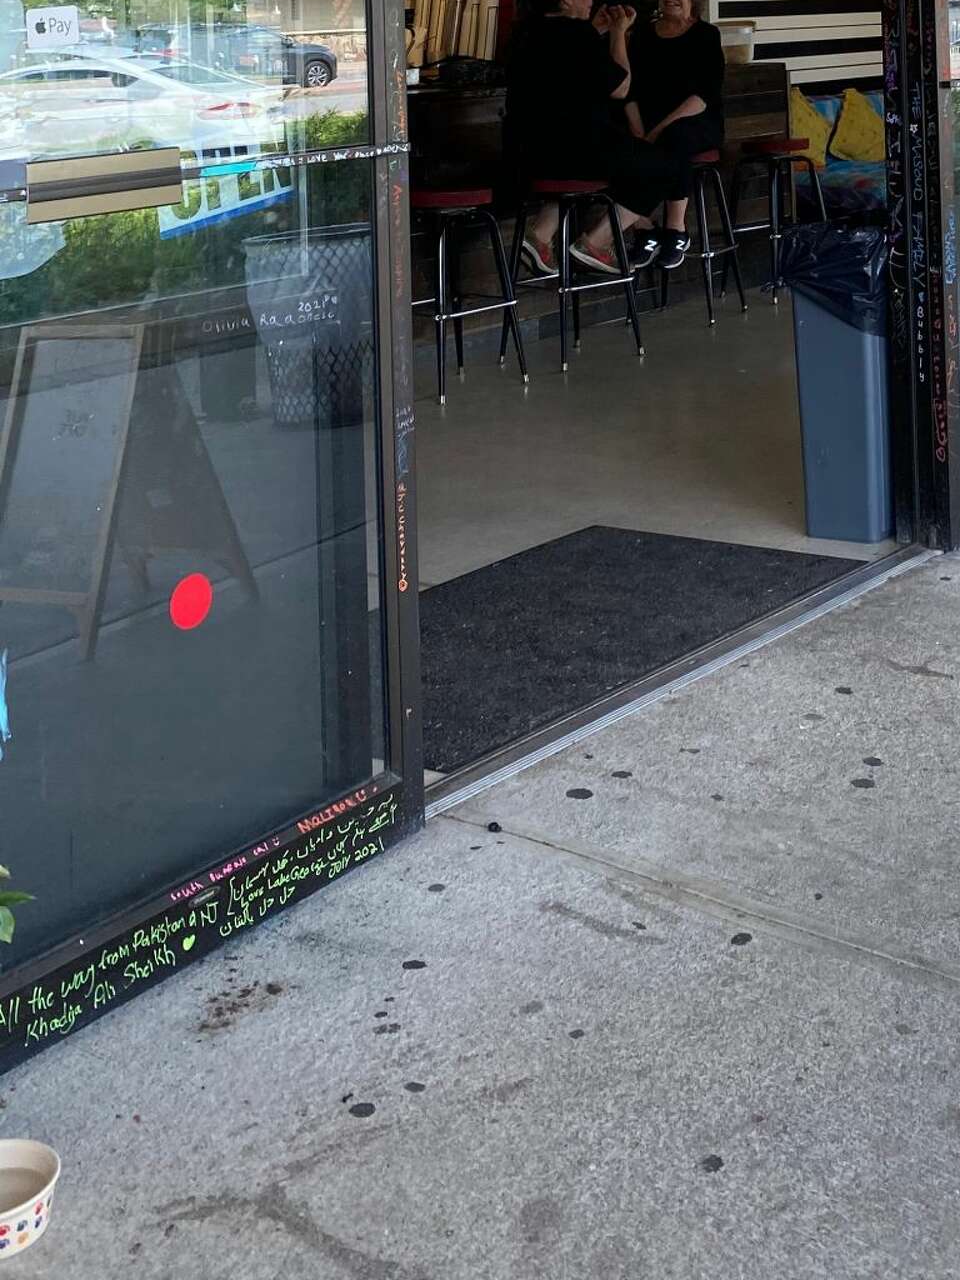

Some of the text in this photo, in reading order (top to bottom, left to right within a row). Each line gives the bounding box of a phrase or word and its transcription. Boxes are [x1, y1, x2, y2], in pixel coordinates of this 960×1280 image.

[48, 18, 72, 35] Pay
[354, 836, 385, 862] 2021
[28, 986, 54, 1014] the
[61, 964, 95, 998] way
[132, 916, 186, 953] Pakistan
[201, 901, 220, 928] NJ
